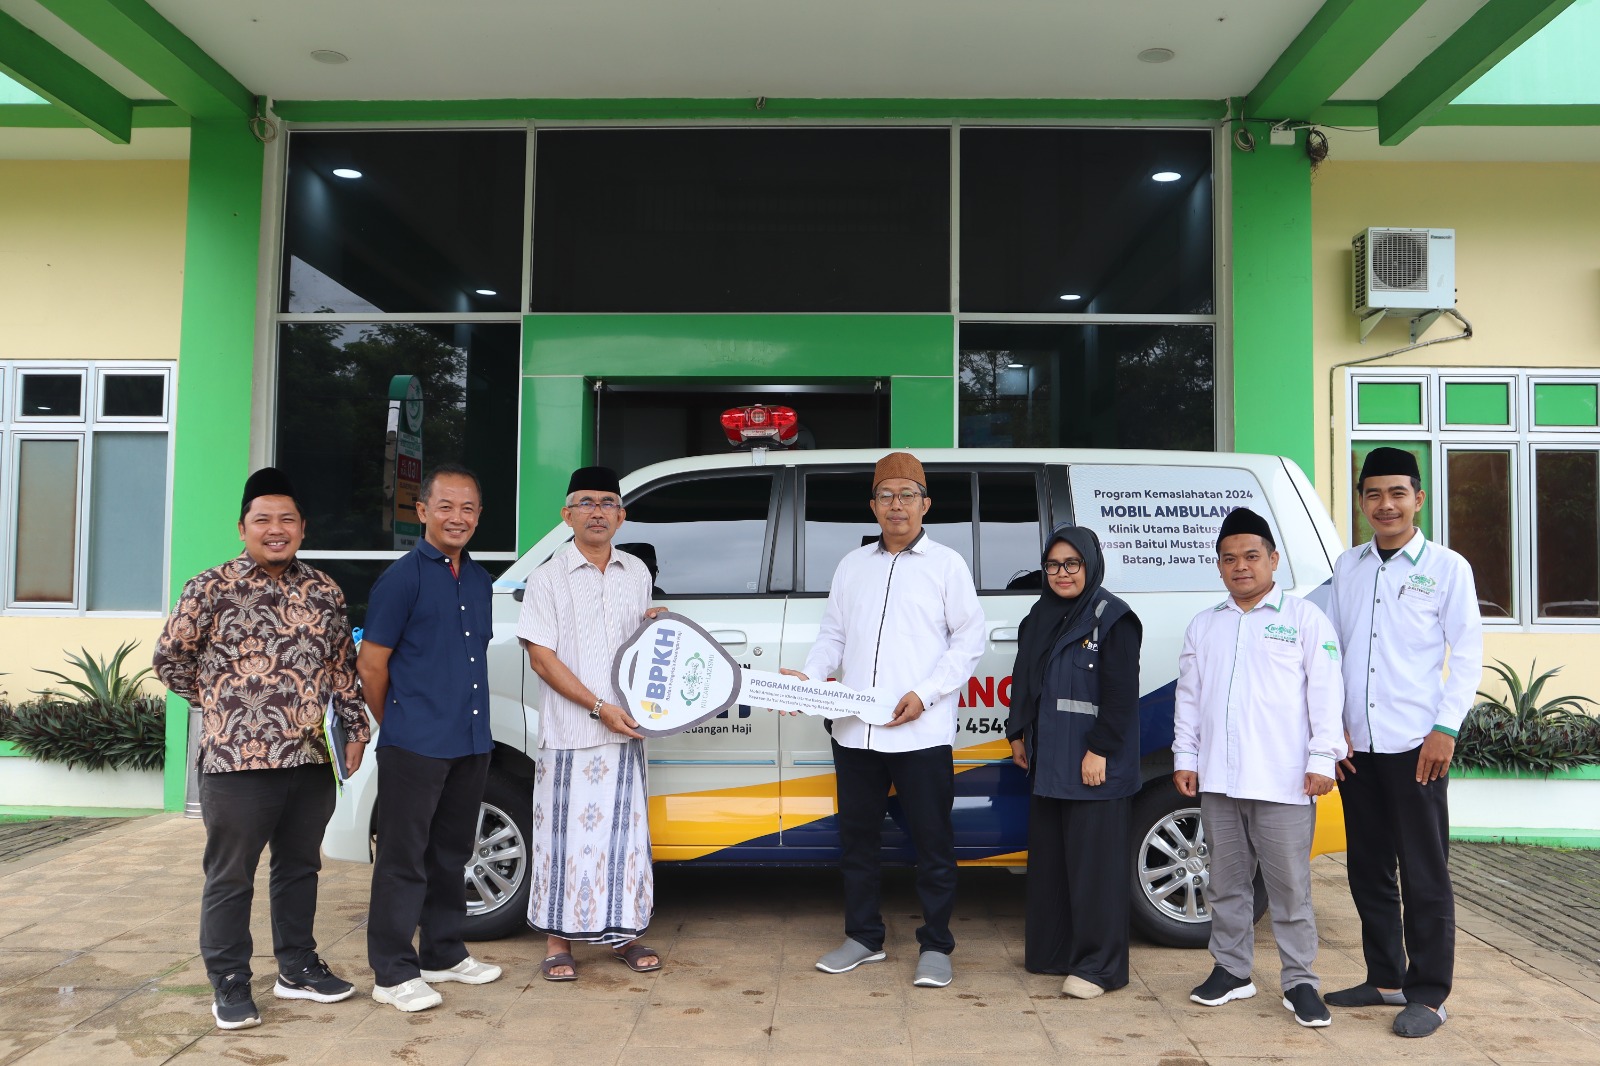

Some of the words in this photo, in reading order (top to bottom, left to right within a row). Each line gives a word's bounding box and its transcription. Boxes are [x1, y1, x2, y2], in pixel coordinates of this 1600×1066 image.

[1094, 489, 1141, 500] Program
[1144, 489, 1223, 499] Kemaslahatan
[1225, 489, 1254, 499] 2024
[1100, 505, 1151, 518] MOBIL
[1154, 505, 1250, 518] AMBULAN
[1108, 523, 1141, 534] Klinik
[1142, 523, 1180, 534] Utama
[1100, 541, 1133, 551] yasan
[1135, 539, 1168, 549] Baitul
[1170, 539, 1216, 549] Mustasf
[1122, 554, 1166, 566] Batang,
[1168, 554, 1196, 564] Jawa
[1198, 554, 1218, 564] Ten
[645, 627, 676, 700] BPKH
[750, 678, 790, 691] PROGRAM
[791, 684, 855, 700] KEMASLAHATAN
[855, 694, 876, 703] 2024
[682, 725, 729, 736] uangan
[731, 723, 752, 735] Haji
